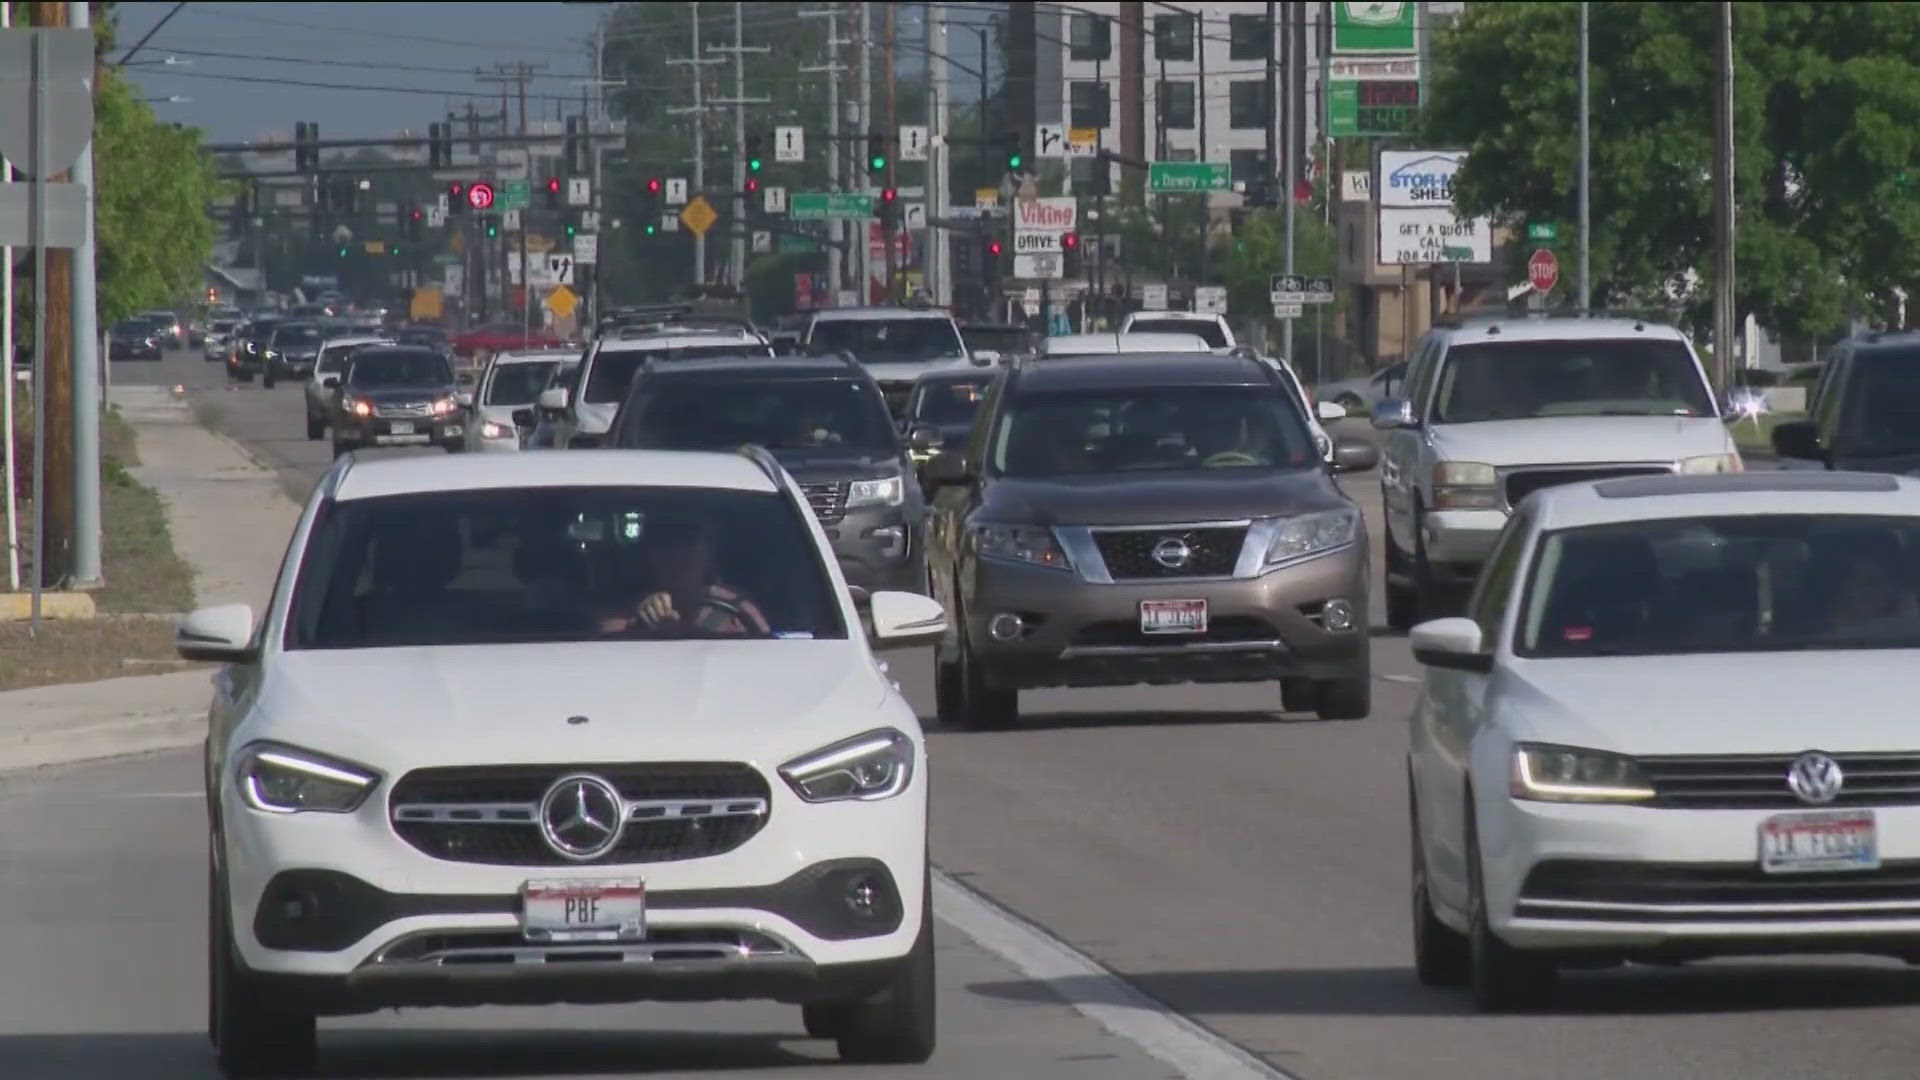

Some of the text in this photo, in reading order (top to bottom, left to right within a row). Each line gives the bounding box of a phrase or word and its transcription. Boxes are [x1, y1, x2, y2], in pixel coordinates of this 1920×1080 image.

[1019, 201, 1074, 226] Viking
[1400, 222, 1475, 236] GET A QUOTE
[1420, 237, 1447, 248] CALL
[1397, 251, 1419, 262] 208
[1532, 263, 1556, 279] STOP
[565, 898, 599, 923] PBF
